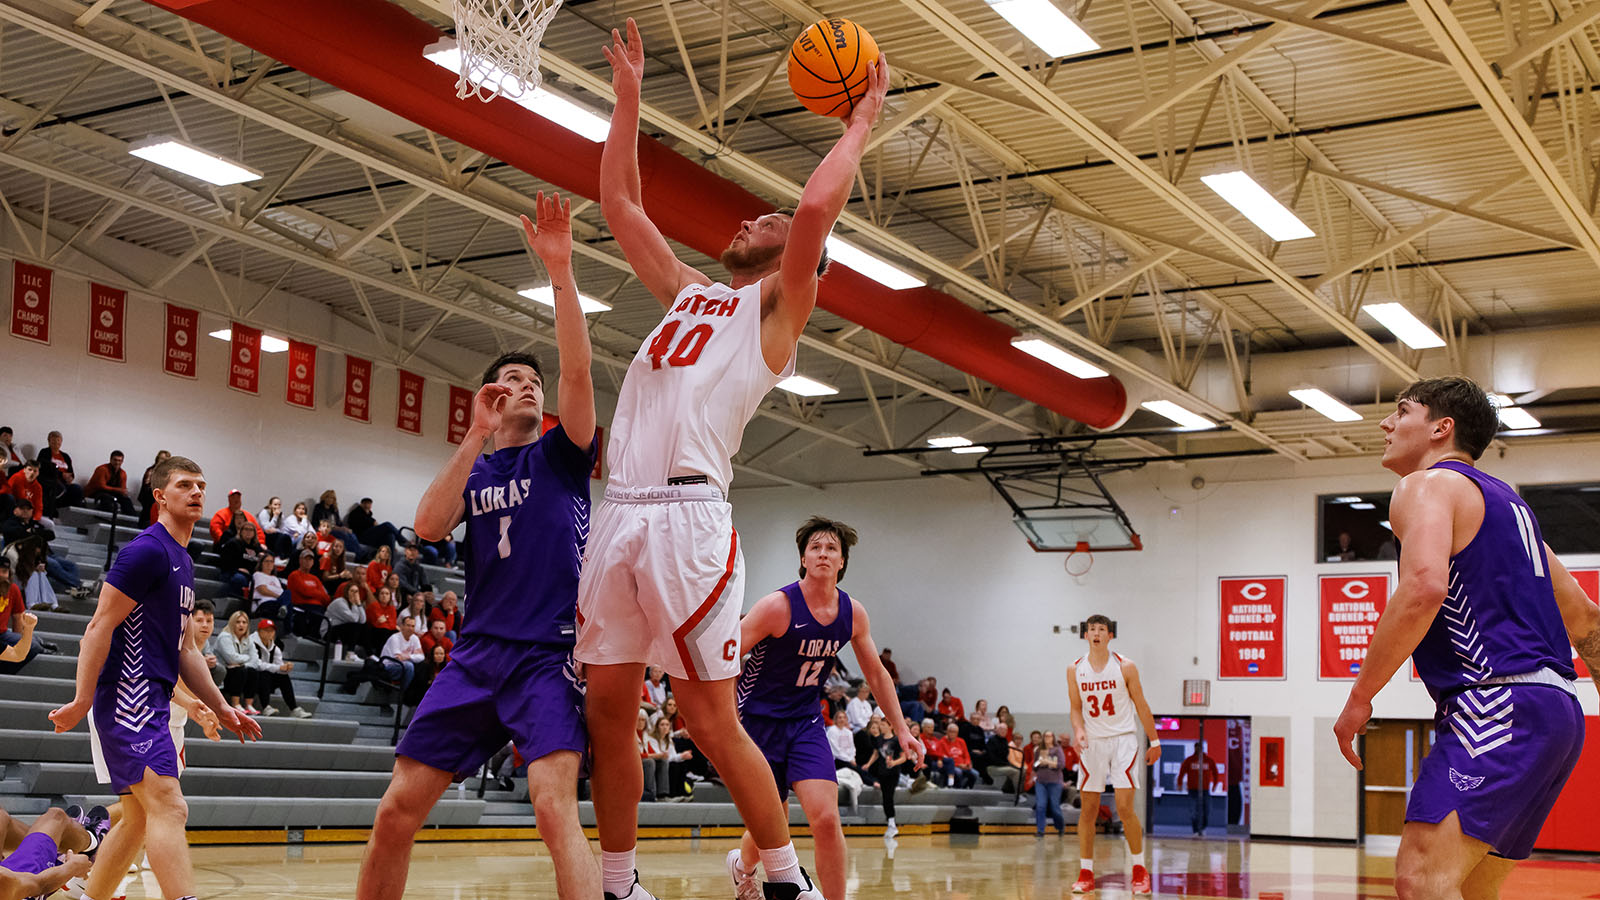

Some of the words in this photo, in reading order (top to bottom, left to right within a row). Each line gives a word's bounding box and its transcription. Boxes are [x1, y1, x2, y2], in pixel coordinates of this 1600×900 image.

[22, 274, 42, 288] IIAC
[98, 295, 116, 308] IIAC
[16, 309, 45, 325] CHAMPS
[173, 315, 190, 328] IIAC
[22, 323, 39, 336] 1958
[94, 329, 119, 344] CHAMPS
[647, 320, 714, 371] 40
[168, 347, 192, 362] CHAMPS
[232, 364, 255, 379] CHAMPS
[289, 380, 311, 394] CHAMPS
[470, 478, 531, 517] LORAS
[1509, 501, 1545, 577] 11
[1232, 604, 1273, 613] NATIONAL
[1332, 602, 1375, 612] NATIONAL
[1228, 614, 1277, 624] RUNNER-UP
[1328, 612, 1380, 622] RUNNER-UP
[1229, 630, 1275, 641] FOOTBALL
[1333, 625, 1374, 635] WOMEN'S
[1339, 635, 1369, 645] TRACK
[723, 639, 737, 662] C
[798, 639, 840, 657] LORAS
[1238, 647, 1266, 661] 1984
[796, 660, 825, 687] 12
[1081, 680, 1117, 692] DUTCH
[1087, 693, 1116, 718] 34
